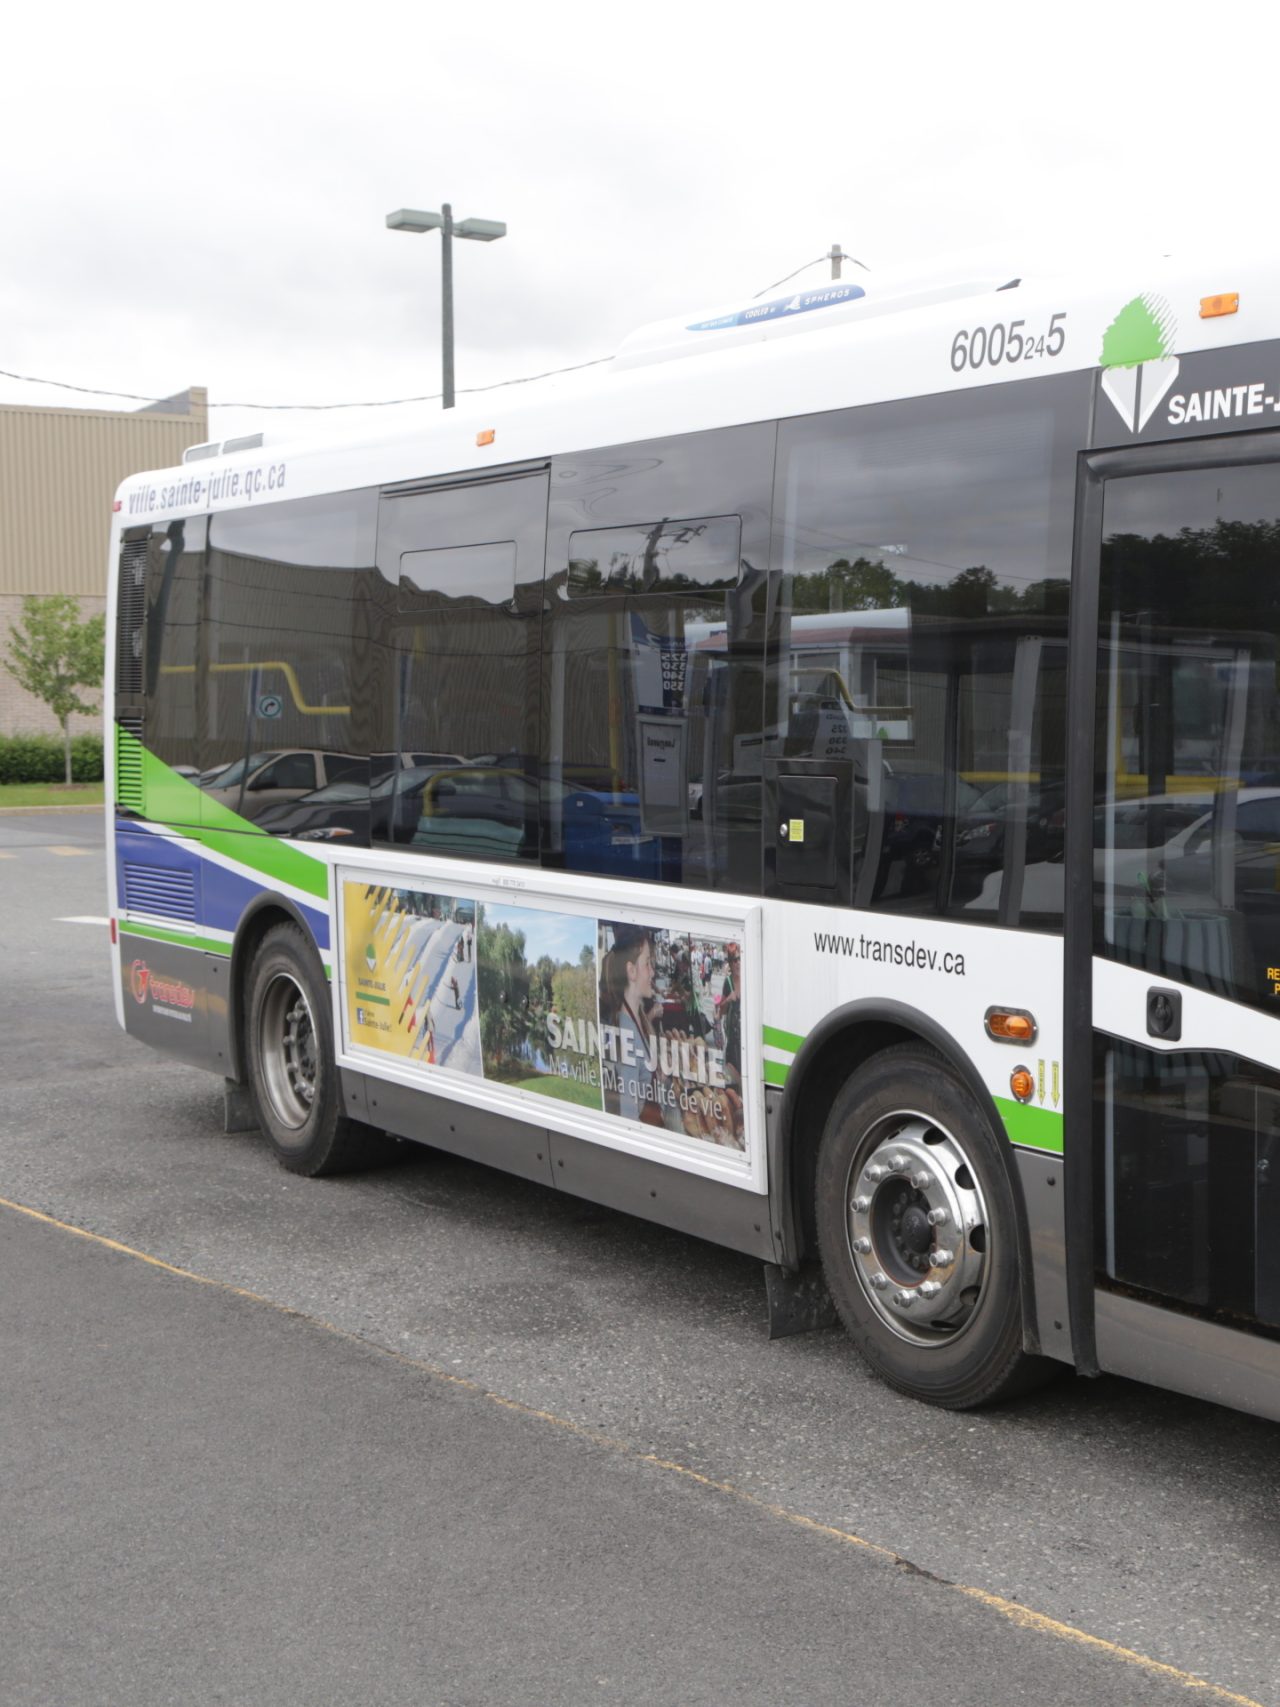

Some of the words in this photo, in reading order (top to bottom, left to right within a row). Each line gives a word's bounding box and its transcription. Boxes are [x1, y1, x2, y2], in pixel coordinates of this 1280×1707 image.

[804, 288, 850, 305] SPHEROS
[128, 463, 287, 514] ville.sainte-julie.qc.ca
[814, 932, 965, 976] www.transdev.ca
[546, 1012, 726, 1089] SAINTE-JULIE
[549, 1054, 569, 1079] Ma
[571, 1059, 601, 1088] ville.
[603, 1067, 625, 1093] Ma
[628, 1079, 677, 1108] qualité
[679, 1087, 698, 1114] de
[701, 1093, 727, 1121] vie.
